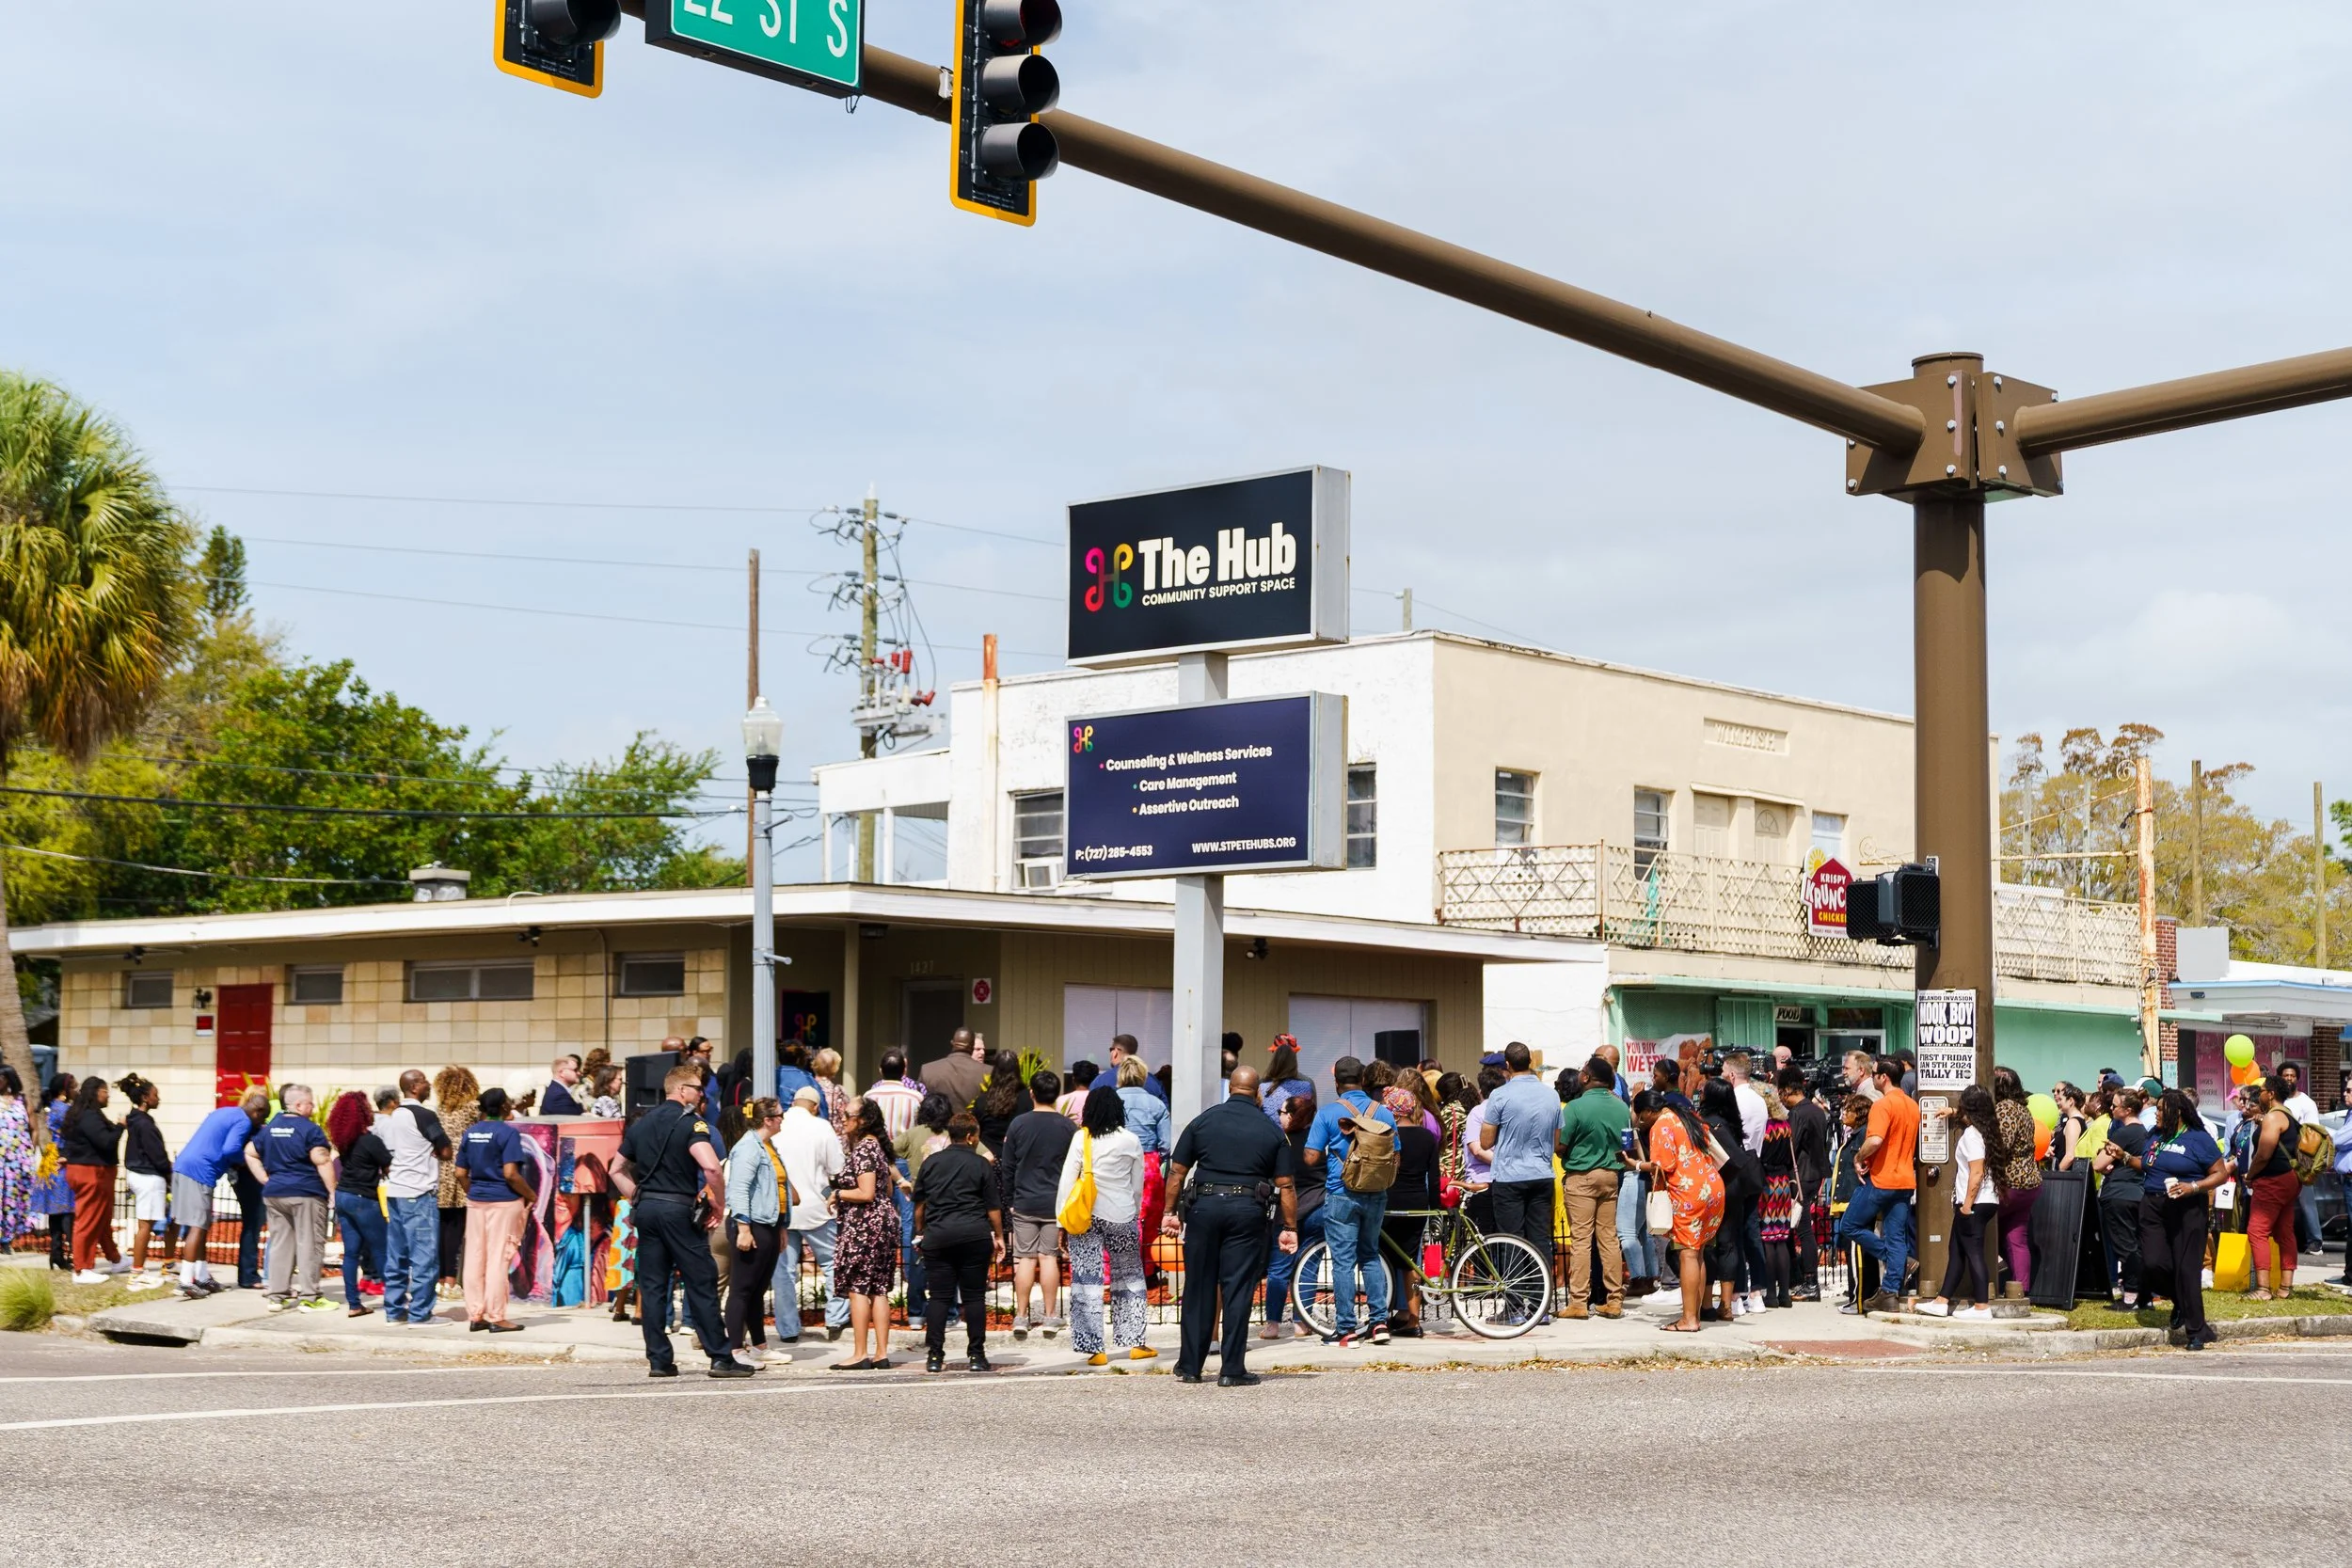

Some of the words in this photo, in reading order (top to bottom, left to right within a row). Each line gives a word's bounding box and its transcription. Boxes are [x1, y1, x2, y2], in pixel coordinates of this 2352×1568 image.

[827, 0, 848, 58] S
[1138, 537, 1211, 591] The
[1217, 522, 1296, 581] Hub
[1142, 587, 1206, 607] COMMUNITY
[1209, 581, 1257, 598] SUPPORT
[1260, 577, 1295, 593] SPACE
[1105, 752, 1168, 772] Counseling
[1168, 753, 1176, 767] &
[1176, 750, 1224, 766] Wellness
[1225, 745, 1273, 761] Services
[1139, 779, 1166, 792] Care
[1166, 771, 1238, 791] Management
[1139, 800, 1188, 816] Assertive
[1188, 796, 1240, 812] Outreach
[1075, 849, 1085, 861] P:
[1085, 845, 1107, 862] (727)
[1107, 845, 1153, 859] 285-4553
[1191, 836, 1297, 854] WWW.STPETEHUBS.ORG
[1820, 872, 1847, 885] KRISPY
[1804, 879, 1847, 911] KRUNC
[1818, 911, 1847, 924] CHICKE
[1776, 1007, 1799, 1021] FOOD
[1949, 1002, 1974, 1025] BOY
[1626, 1041, 1641, 1054] YOU
[1642, 1041, 1657, 1054] BUY
[1626, 1055, 1645, 1072] WE
[1920, 1069, 1951, 1079] TALLY
